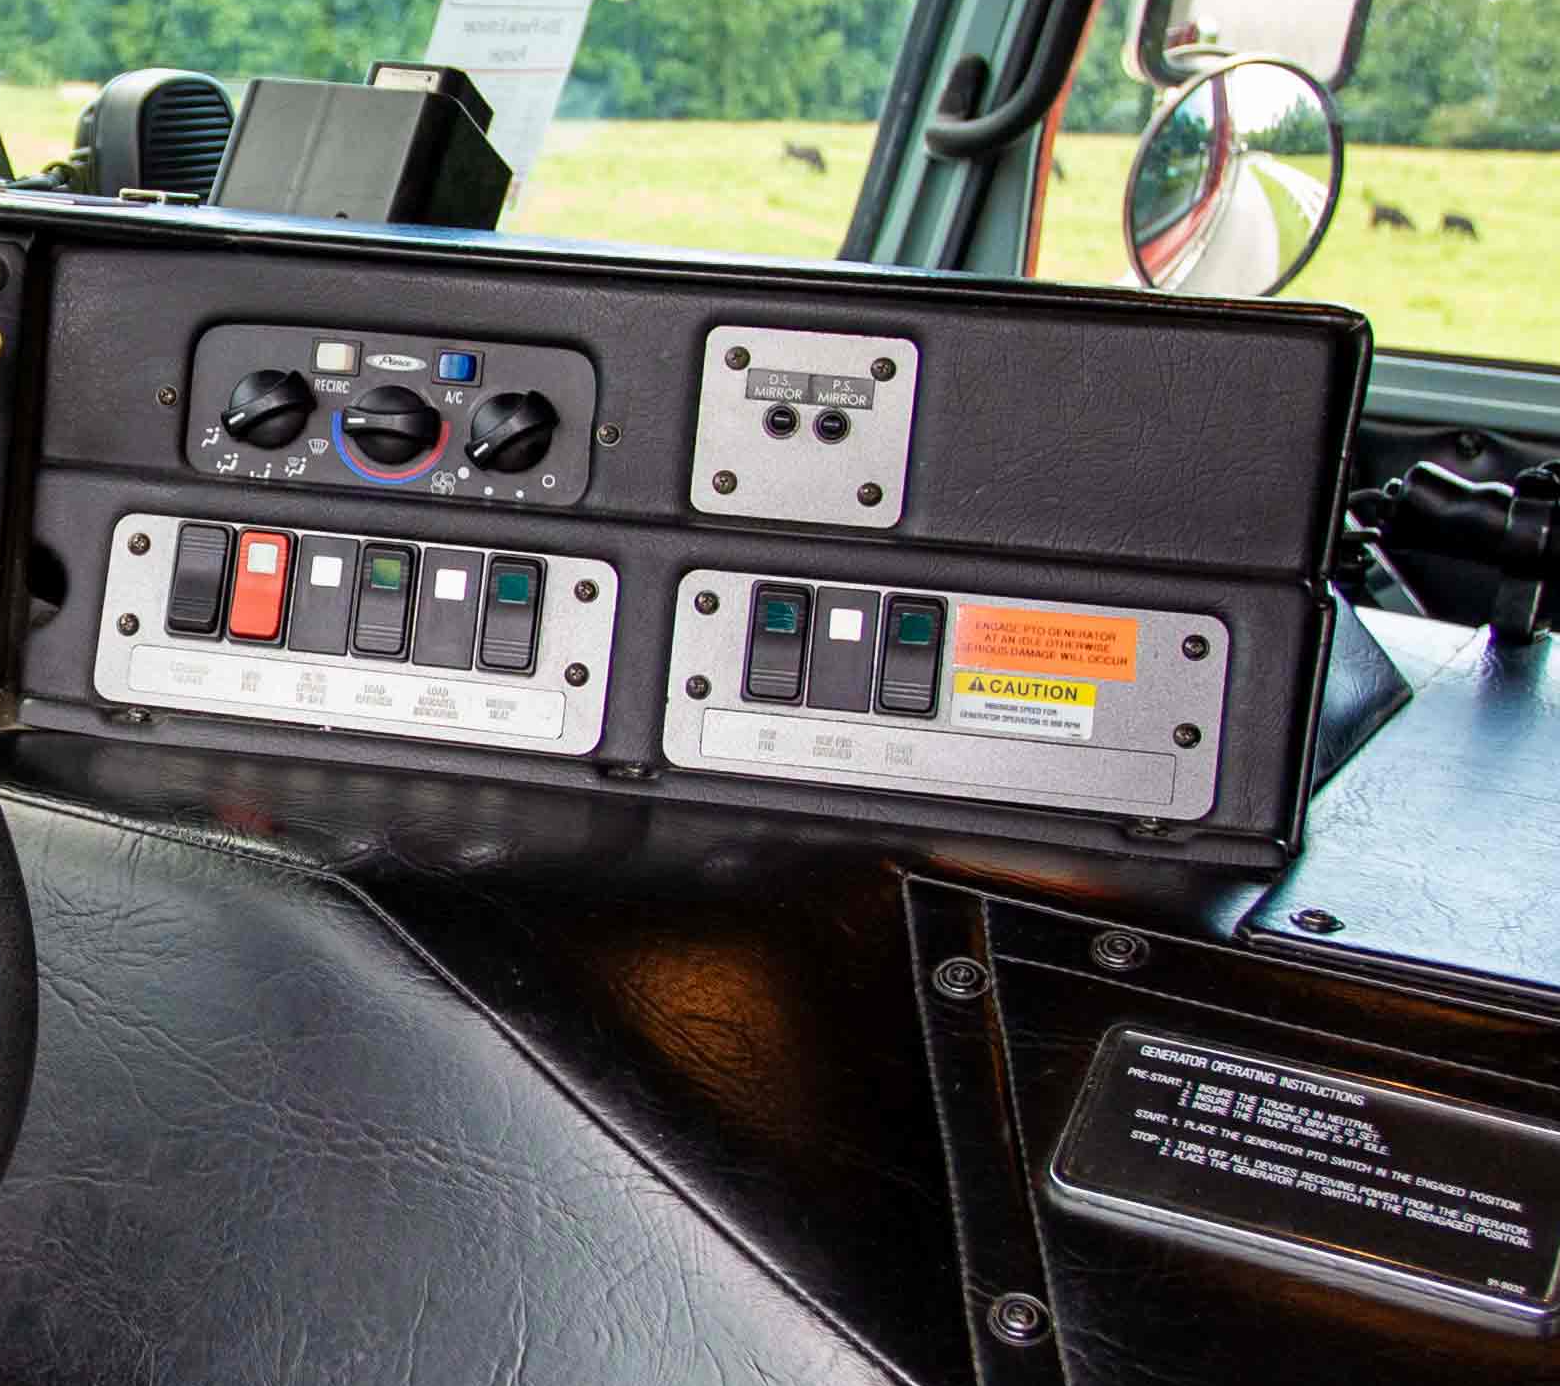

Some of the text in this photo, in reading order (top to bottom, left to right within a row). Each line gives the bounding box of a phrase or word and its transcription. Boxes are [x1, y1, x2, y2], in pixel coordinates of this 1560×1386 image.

[314, 379, 350, 394] RECIRC
[769, 374, 791, 386] D.S.
[832, 380, 854, 392] P.S.
[445, 391, 464, 404] A/C
[754, 387, 802, 399] MIRROR
[818, 393, 866, 406] MIRROR
[975, 621, 1117, 642] ENGAGE PTO GENERATOR
[985, 633, 1110, 653] AT AN IDLE OTHERWISE
[1010, 647, 1056, 660] DAMAGE
[1060, 651, 1083, 660] WILL
[1087, 655, 1128, 666] OCCUR
[989, 679, 1078, 701] CAUTION
[1140, 1045, 1365, 1106] GENERATOR OPERATING INSTRUCTIONS
[1128, 1067, 1182, 1087] PRE-START:
[1198, 1083, 1235, 1099] INSURE
[1238, 1093, 1259, 1105] THE
[1262, 1098, 1296, 1113] TRUCK
[1298, 1106, 1310, 1116] IS
[1312, 1110, 1325, 1119] IN
[1194, 1092, 1231, 1108] INSURE
[1235, 1101, 1256, 1114] THE
[1258, 1107, 1303, 1124] PARKING
[1305, 1118, 1341, 1134] BRAKE
[1344, 1128, 1355, 1136] IS
[1191, 1102, 1229, 1116] INSURE
[1232, 1110, 1252, 1122] THE
[1256, 1116, 1288, 1131] TRUCK
[1292, 1124, 1328, 1140] ENGINE
[1332, 1135, 1344, 1144] IS
[1347, 1138, 1360, 1148] AT
[1183, 1120, 1217, 1135] PLACE
[1220, 1128, 1241, 1141] THE
[1243, 1135, 1304, 1157] GENERATOR
[1306, 1150, 1328, 1163] PTO
[1330, 1156, 1372, 1174] SWITCH
[1375, 1167, 1388, 1178] IN
[1391, 1171, 1413, 1184] THE
[1415, 1177, 1467, 1197] ENGAGED
[1130, 1129, 1161, 1144] STOP:
[1177, 1140, 1205, 1155] TURN
[1207, 1148, 1229, 1159] OFF
[1230, 1154, 1251, 1165] ALL
[1254, 1159, 1298, 1178] DEVICES
[1300, 1171, 1356, 1193] RECEIVING
[1358, 1185, 1399, 1204] POWER
[1402, 1197, 1435, 1212] FROM
[1438, 1206, 1460, 1219] THE
[1173, 1150, 1207, 1165] PLACE
[1210, 1158, 1231, 1171] THE
[1233, 1164, 1294, 1187] GENERATOR
[1295, 1180, 1317, 1192] PTO
[1320, 1186, 1363, 1204] SWITCH
[1365, 1197, 1378, 1207] IN
[1381, 1201, 1402, 1215] THE
[1405, 1207, 1474, 1233] DISENGAGED
